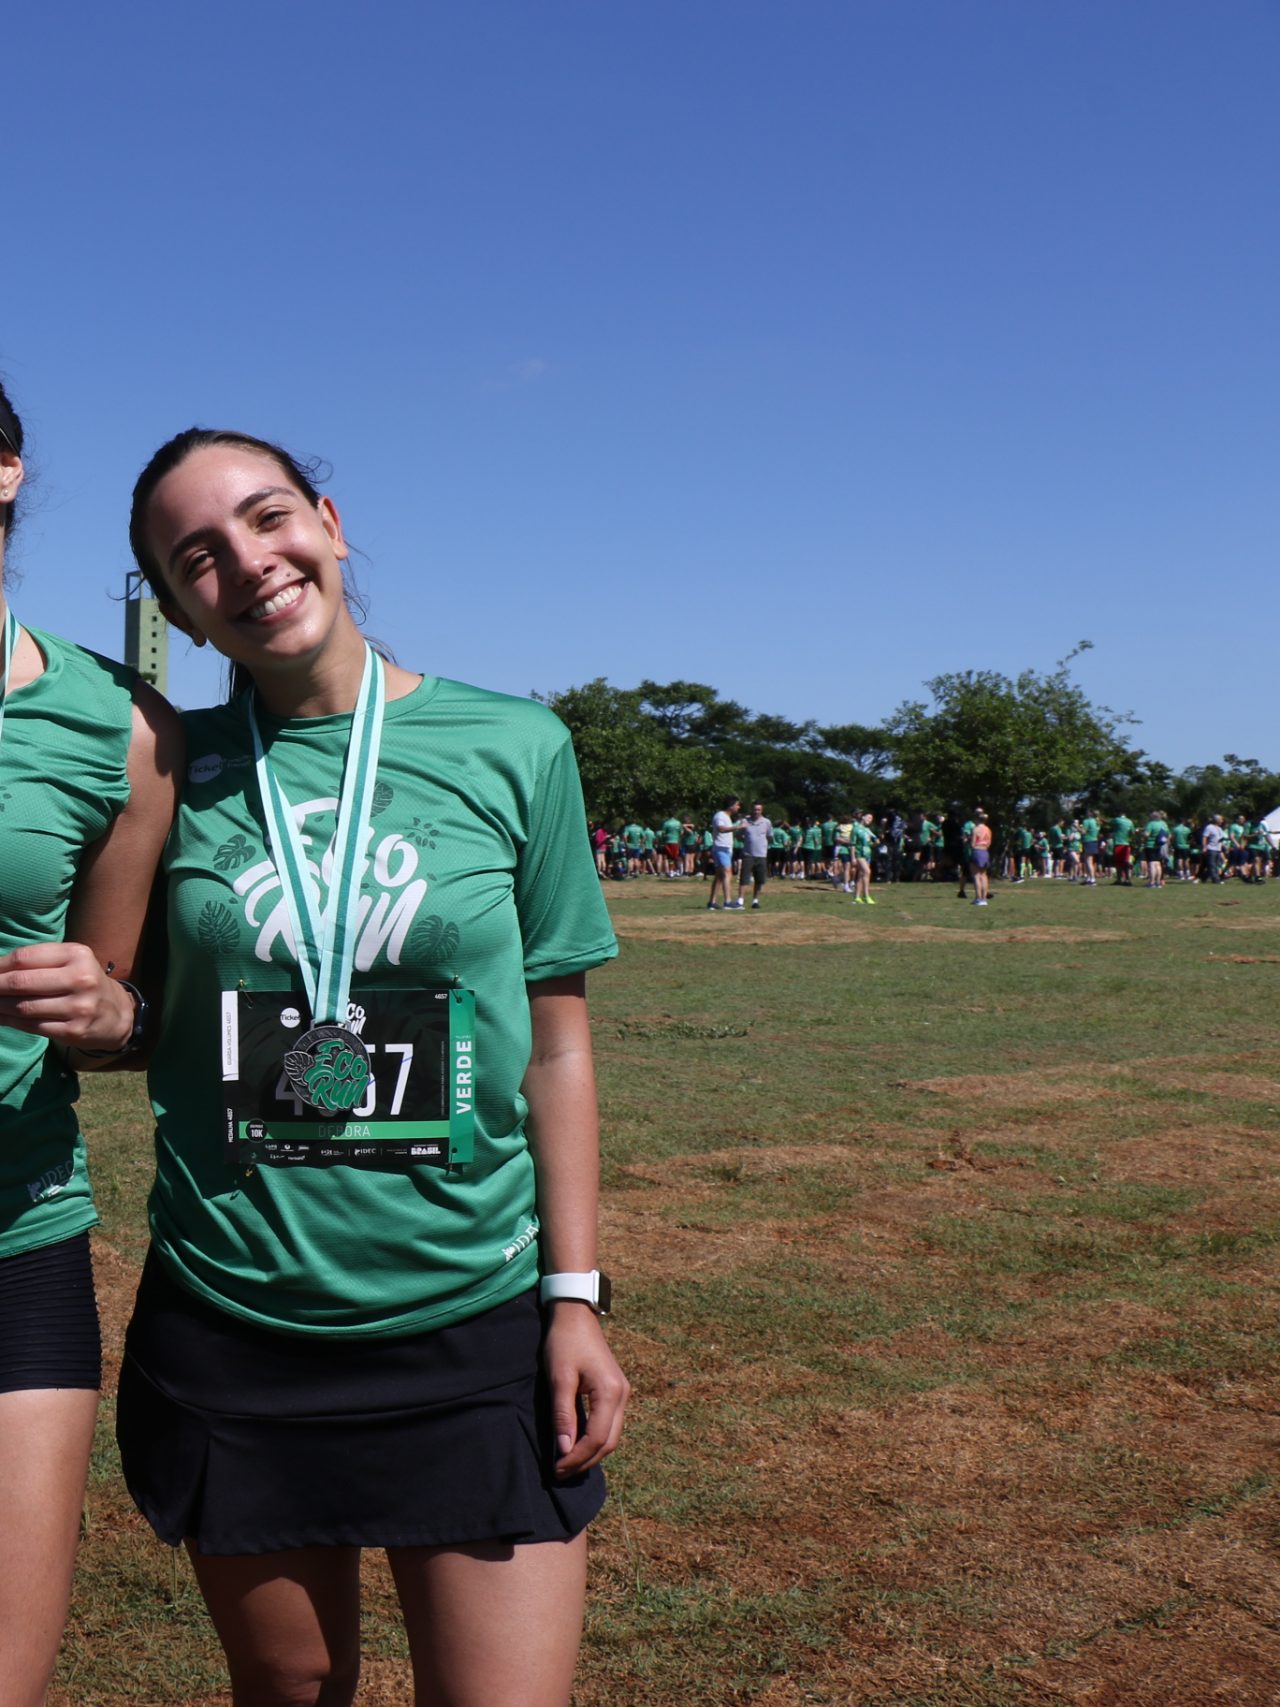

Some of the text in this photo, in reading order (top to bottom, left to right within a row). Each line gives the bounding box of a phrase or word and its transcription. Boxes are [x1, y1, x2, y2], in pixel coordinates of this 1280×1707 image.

[275, 1043, 413, 1117] 457
[456, 1041, 472, 1115] VERDE
[251, 1128, 264, 1138] 10K
[410, 1146, 441, 1156] BRASIL
